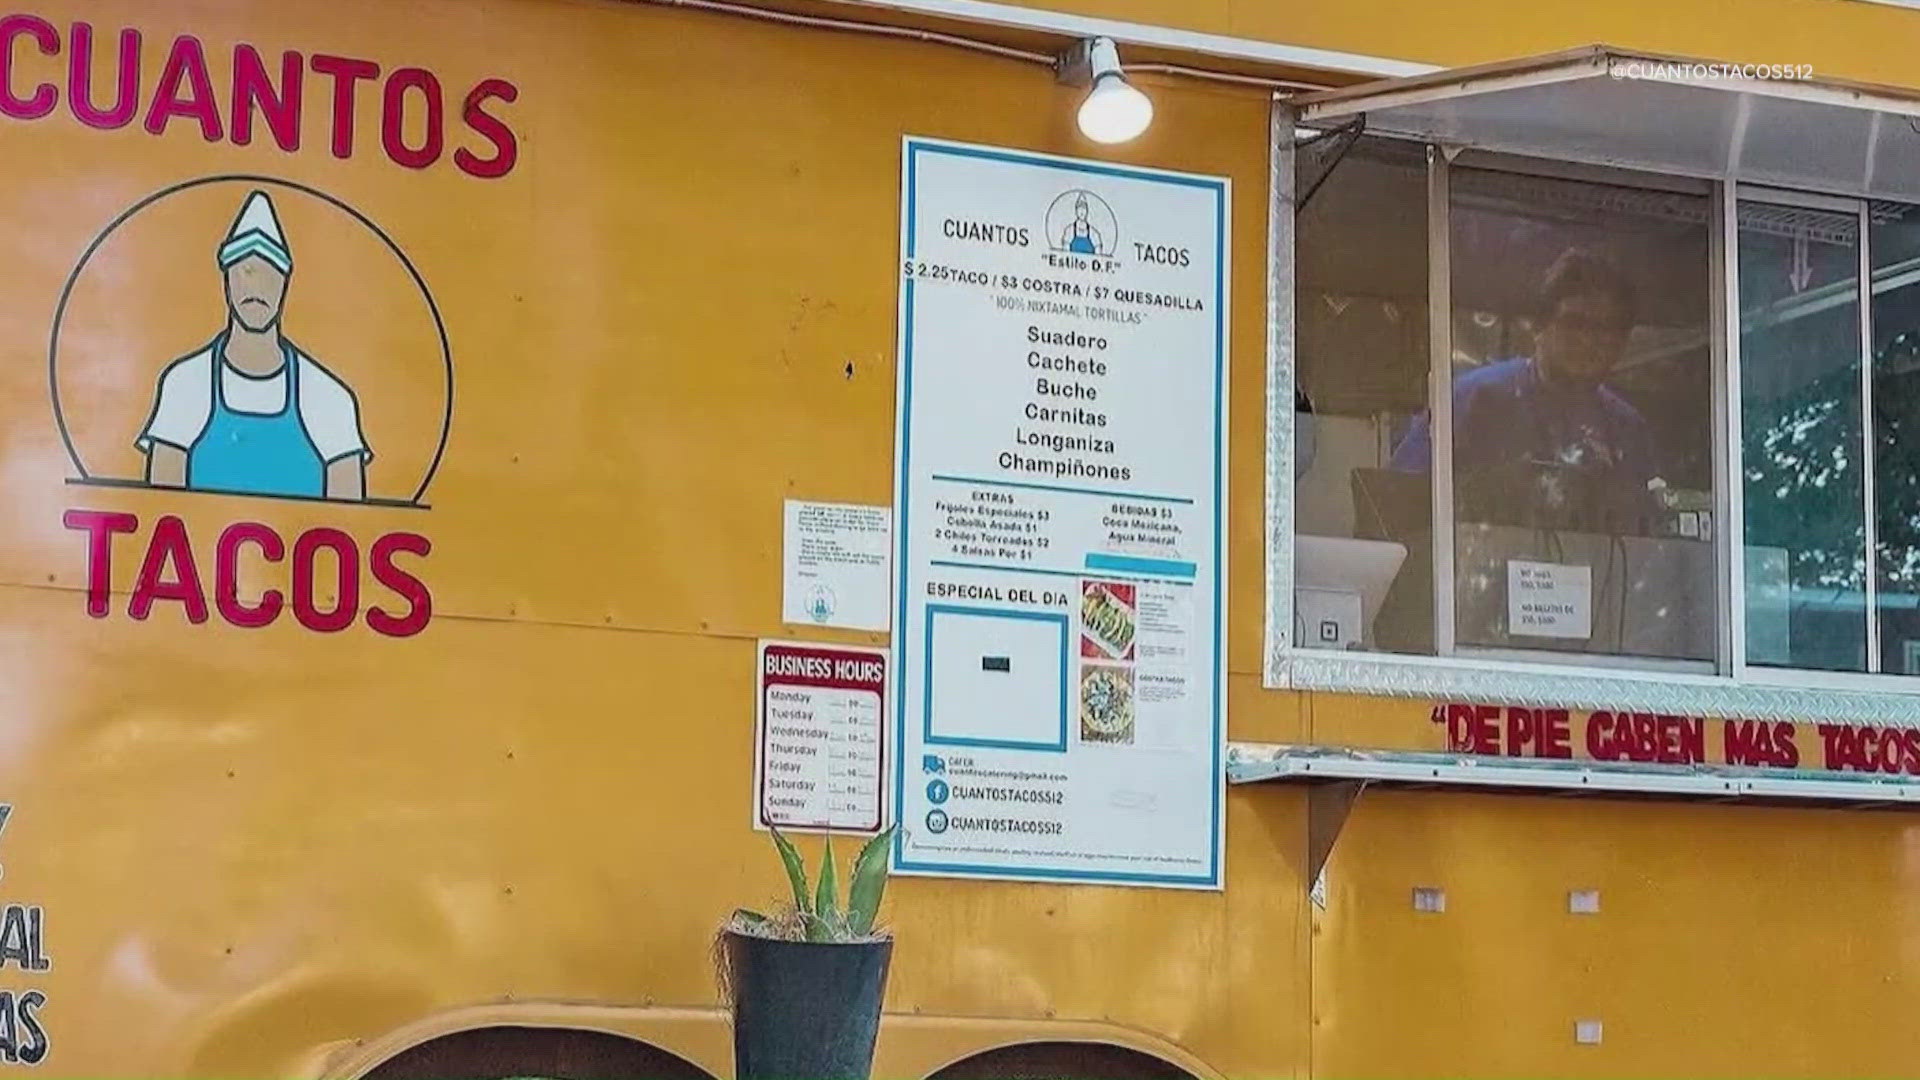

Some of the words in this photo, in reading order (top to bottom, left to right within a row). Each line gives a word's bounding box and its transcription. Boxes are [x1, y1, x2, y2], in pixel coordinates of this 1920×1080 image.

[0, 14, 519, 178] CUANTOS
[943, 219, 1030, 248] CUANTOS
[1134, 242, 1191, 267] TACOS
[1001, 275, 1018, 290] $3
[1022, 277, 1081, 297] COSTRA
[1094, 286, 1109, 300] $7
[1113, 289, 1204, 312] QUESADILLA
[1027, 300, 1080, 318] NIXTAMAL
[1027, 325, 1108, 350] Suadero
[1027, 351, 1107, 376] Cachete
[1036, 378, 1097, 400] Buche
[1025, 403, 1107, 427] Carnitas
[1016, 427, 1114, 454] Longaniza
[999, 452, 1131, 480] Champiñones
[972, 491, 1014, 504] EXTRAS
[1111, 503, 1157, 517] BEBIDAS
[989, 519, 1022, 531] Asada
[1102, 516, 1129, 528] Coca
[944, 529, 977, 543] Chiles
[1108, 531, 1134, 544] Agua
[1137, 533, 1176, 546] Mineral
[62, 508, 432, 638] TACOS
[926, 581, 1002, 602] ESPECIAL
[1007, 589, 1038, 605] DEL
[765, 654, 832, 678] BUSINESS
[834, 659, 883, 683] HOURS
[770, 690, 812, 704] Monday
[770, 707, 814, 722] Tuesday
[770, 725, 829, 740] Wednesday
[1507, 705, 1572, 759] PIE
[1587, 709, 1705, 765] CABEN
[1724, 719, 1799, 768] MAS
[1819, 723, 1920, 776] TACOS
[769, 743, 817, 757] Thursday
[768, 760, 801, 773] Friday
[768, 778, 816, 791] Saturday
[768, 795, 807, 809] Sunday
[951, 785, 1064, 804] CUANTOSTACOS512
[951, 815, 1063, 836] CUANTOSTACOS512
